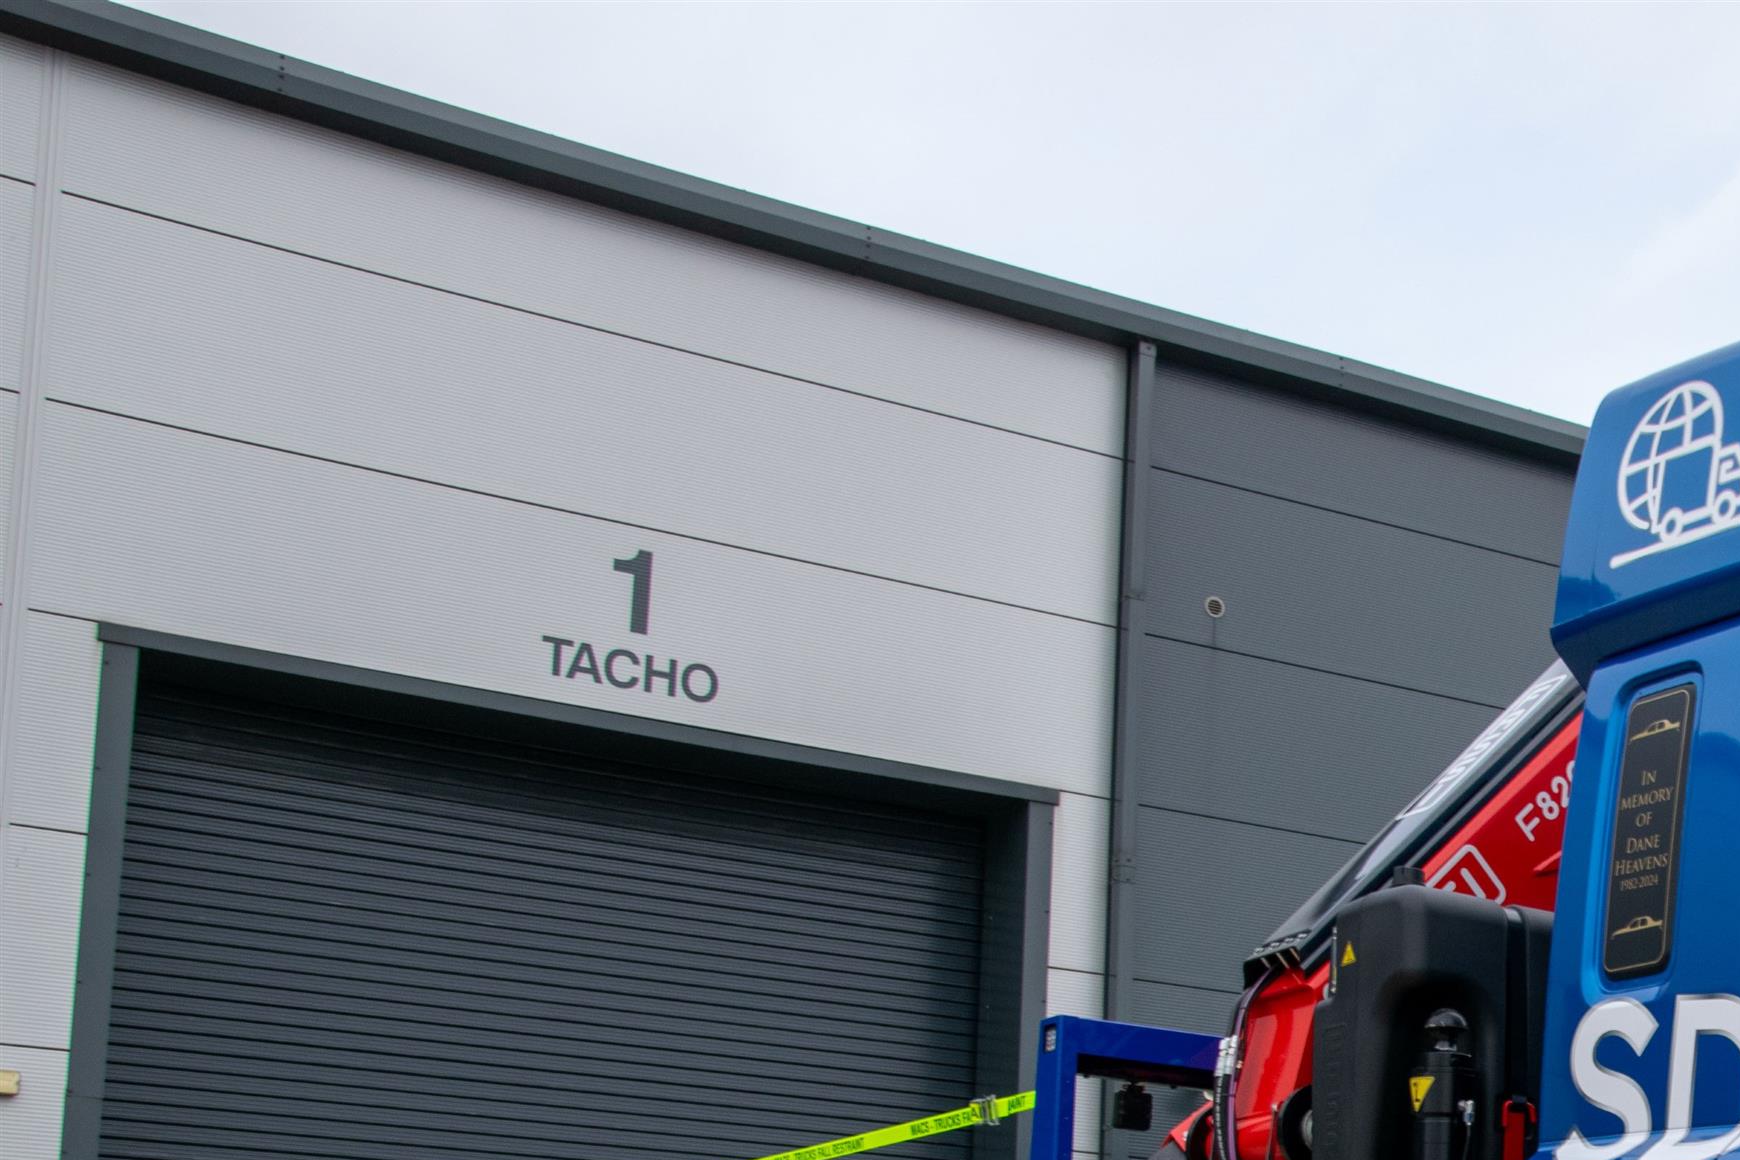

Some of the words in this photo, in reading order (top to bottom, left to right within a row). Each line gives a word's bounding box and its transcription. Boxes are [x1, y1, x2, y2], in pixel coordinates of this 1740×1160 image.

[613, 549, 653, 635] 1
[541, 634, 719, 703] TACHO
[1641, 770, 1657, 785] IN
[1621, 786, 1674, 810] MEMORY
[1636, 811, 1653, 828] OF
[1626, 834, 1660, 854] DANE
[1615, 852, 1669, 876] HEAVENS
